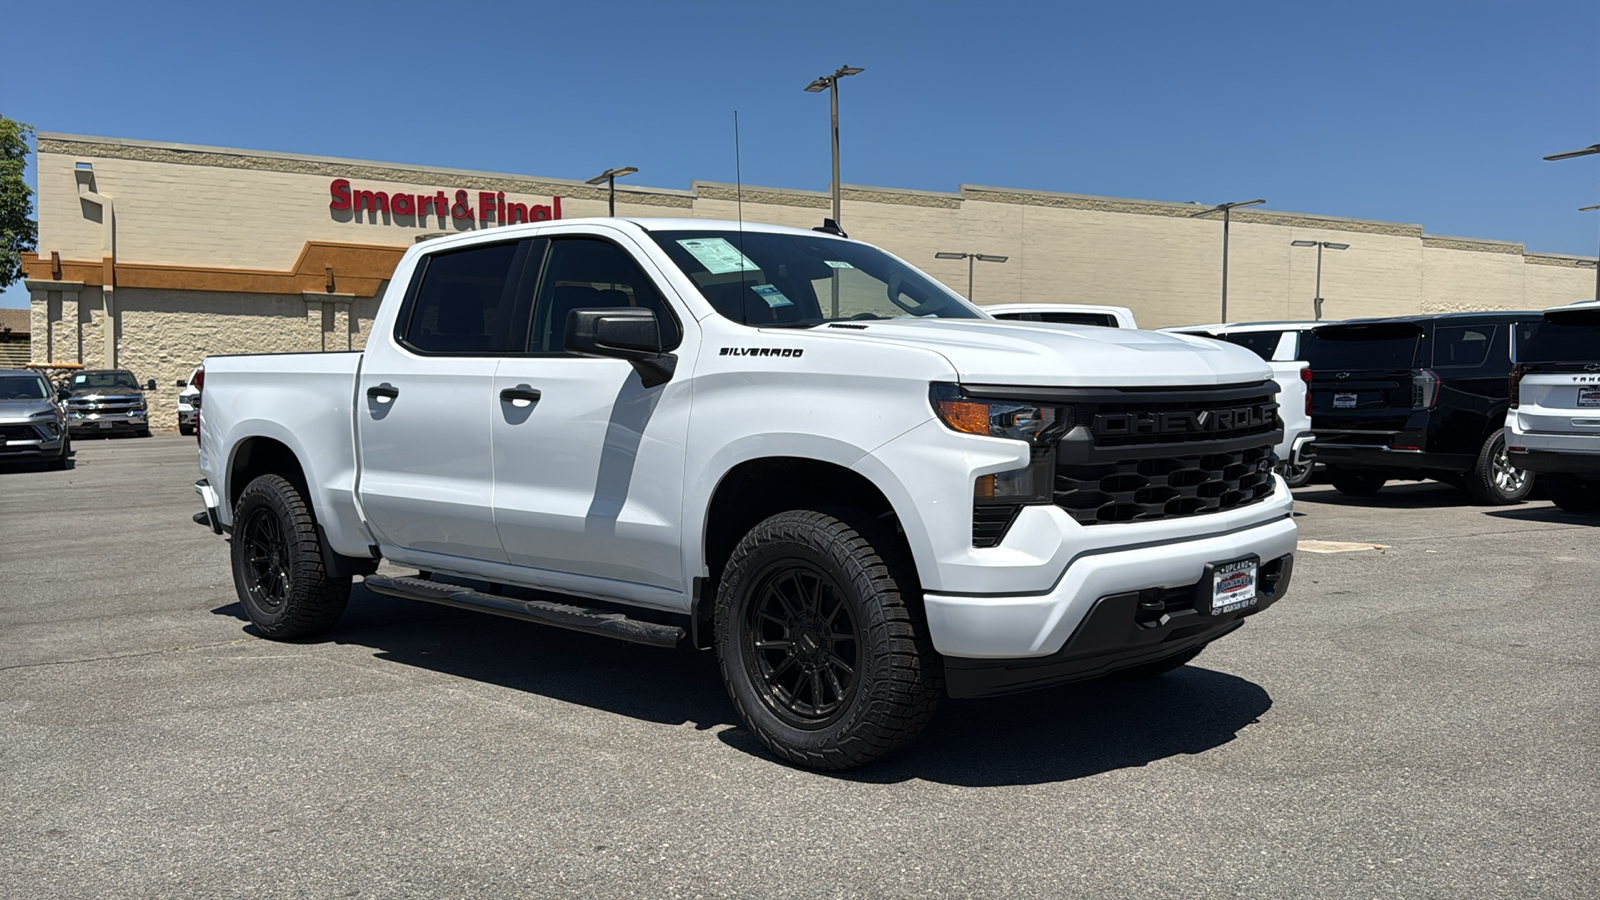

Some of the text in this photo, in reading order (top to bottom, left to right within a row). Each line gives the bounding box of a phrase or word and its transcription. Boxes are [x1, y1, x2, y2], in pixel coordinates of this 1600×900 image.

[329, 178, 562, 223] Smart&Final
[719, 347, 804, 358] SILVERADO
[1094, 403, 1280, 434] CHEVROLE
[1225, 561, 1249, 573] UPLAND
[1223, 602, 1241, 613] MOUNTAIN
